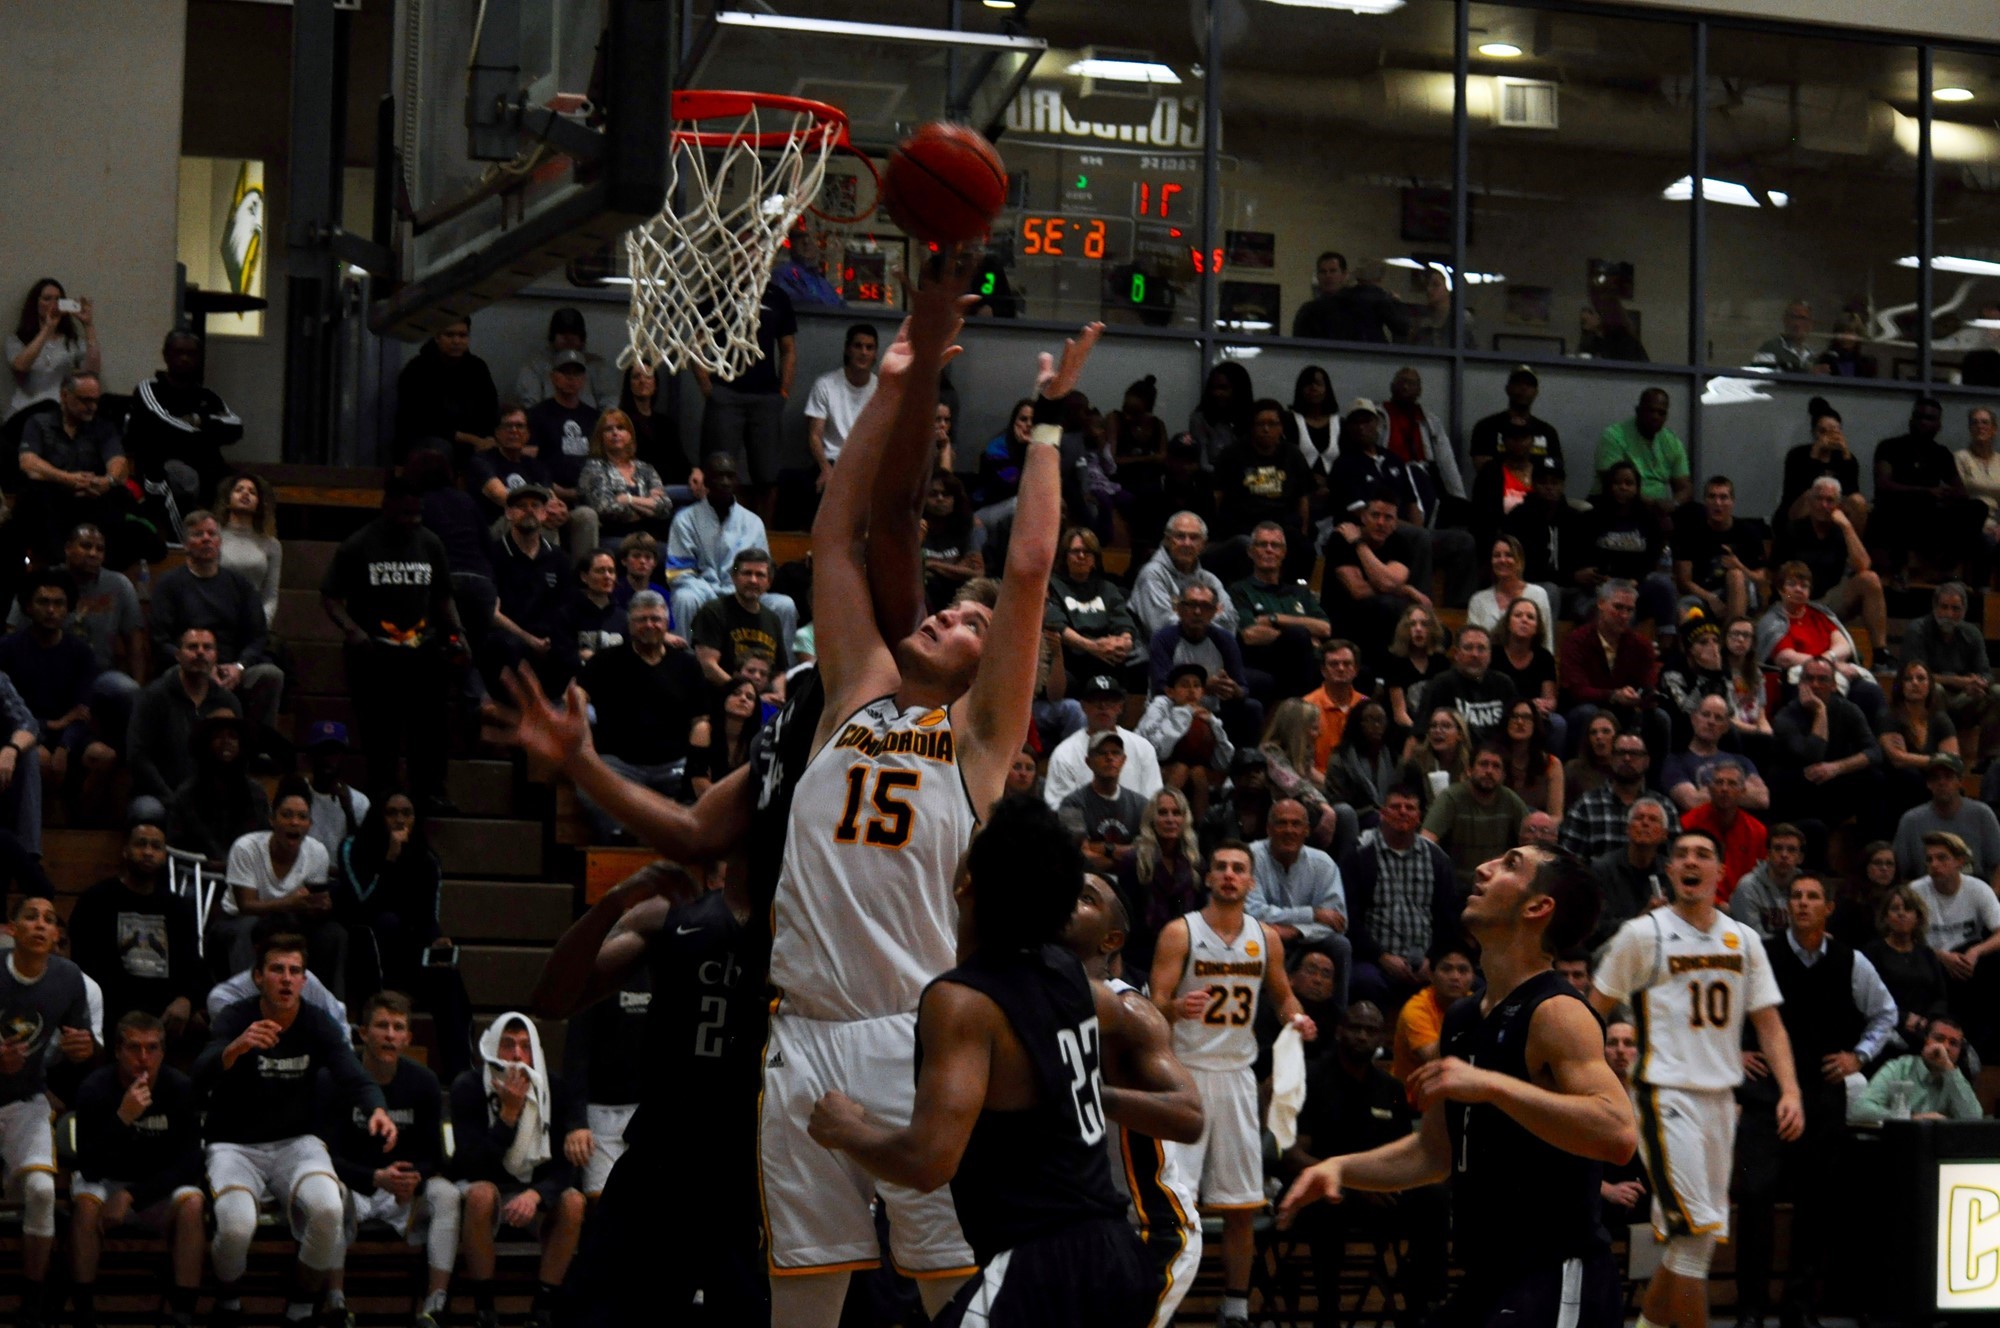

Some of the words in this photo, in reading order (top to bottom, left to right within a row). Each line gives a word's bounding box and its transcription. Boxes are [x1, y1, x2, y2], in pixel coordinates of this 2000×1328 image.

[369, 571, 432, 587] EAGLES
[1454, 696, 1504, 727] VANS
[833, 763, 922, 851] 15
[1203, 983, 1253, 1026] 23
[1688, 980, 1729, 1029] 10
